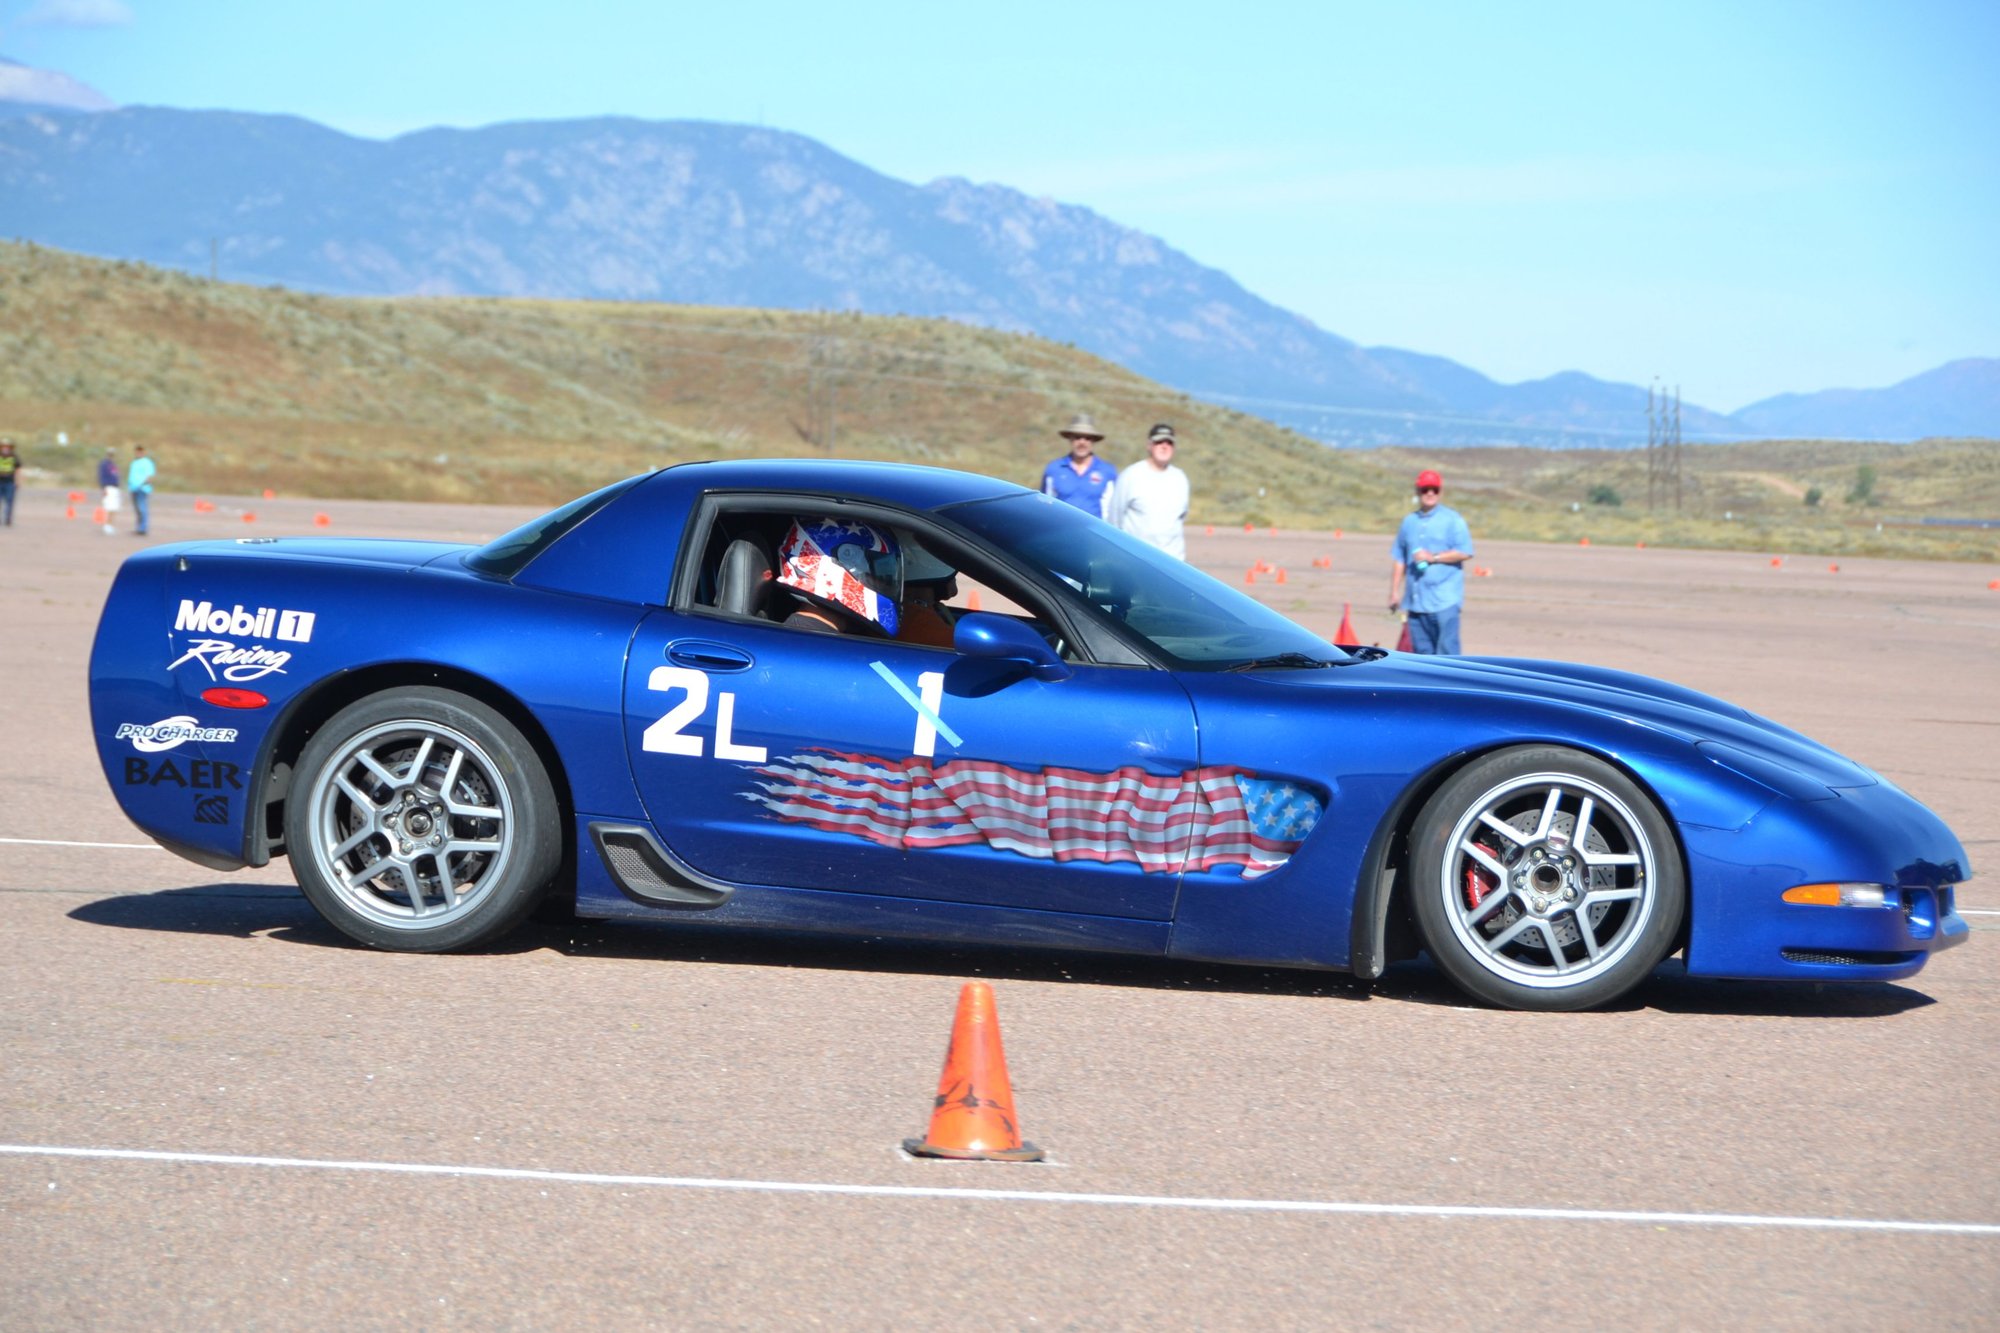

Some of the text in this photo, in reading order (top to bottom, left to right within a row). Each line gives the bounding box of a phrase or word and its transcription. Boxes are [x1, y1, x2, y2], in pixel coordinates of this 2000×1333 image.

[174, 599, 276, 638] Mobil
[166, 638, 292, 682] Racing
[124, 756, 243, 789] BAER
